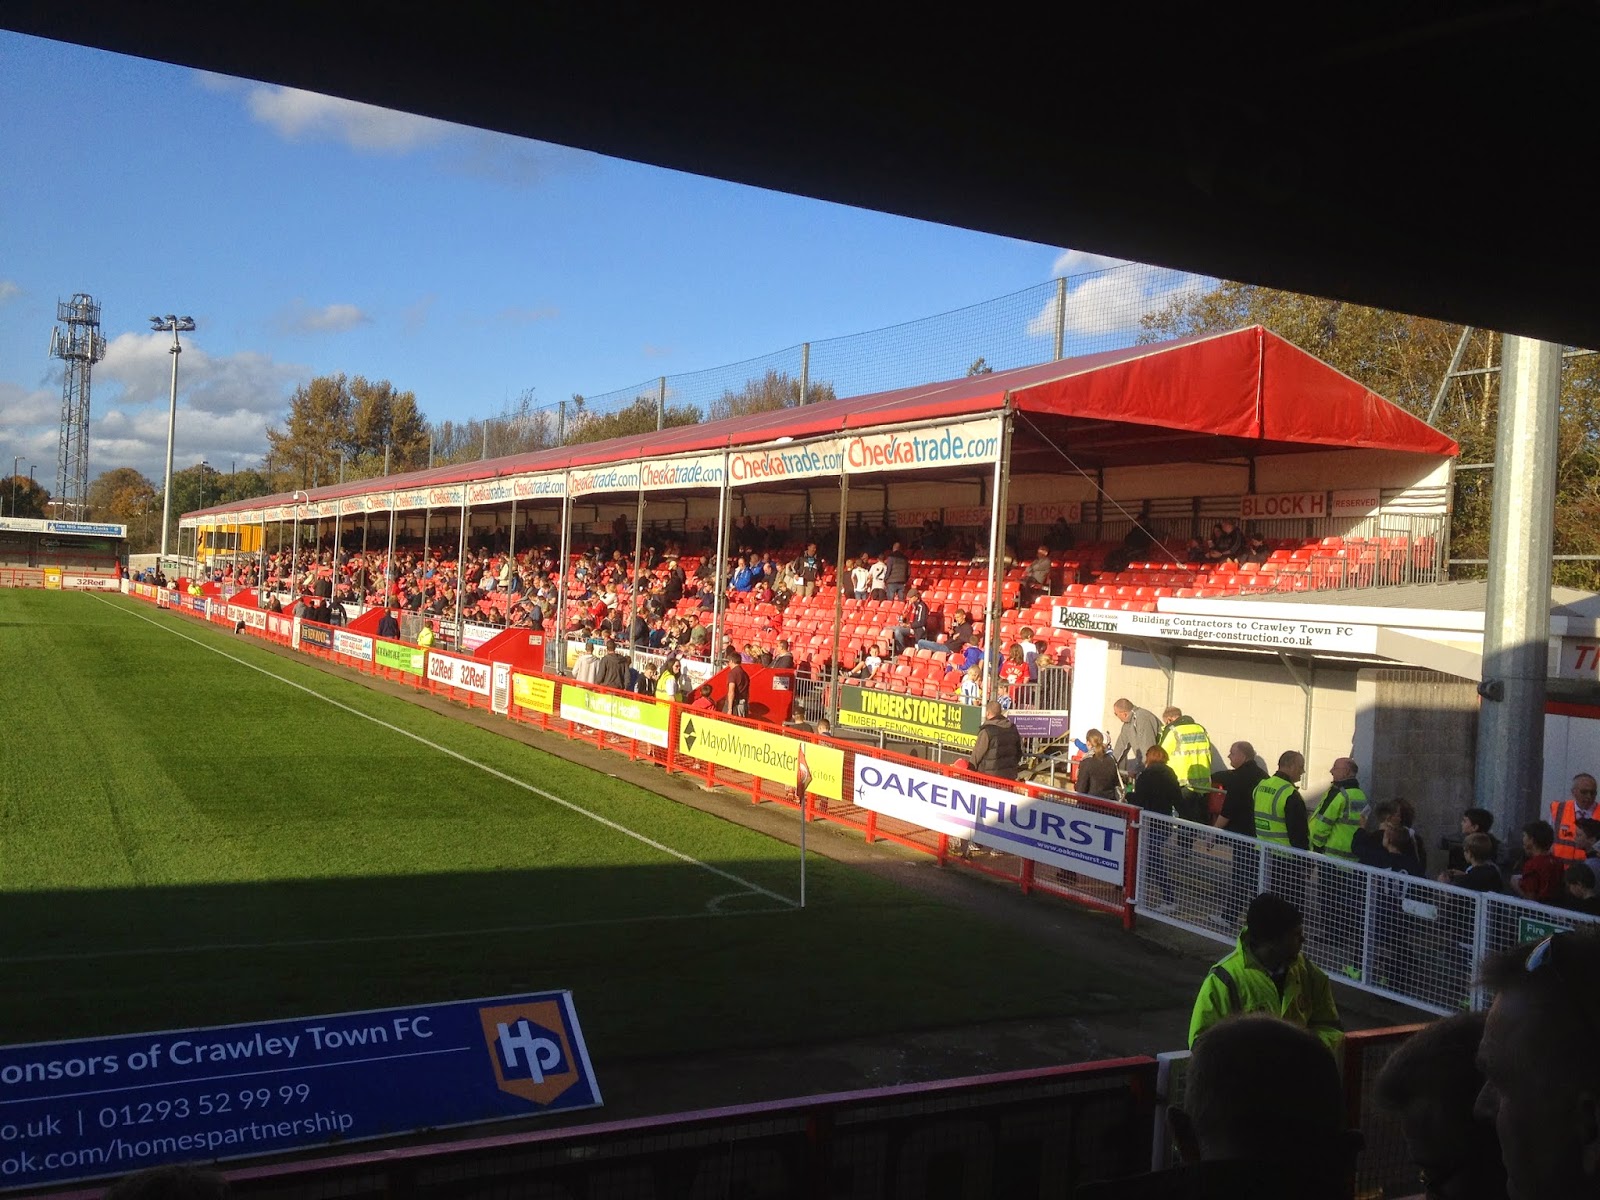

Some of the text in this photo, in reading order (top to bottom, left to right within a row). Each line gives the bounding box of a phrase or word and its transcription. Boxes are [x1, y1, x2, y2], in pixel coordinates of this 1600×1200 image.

[848, 429, 998, 468] Checkatrade.com
[732, 446, 843, 480] Checkatrade.com
[569, 468, 638, 495] Checkatrade.com
[1025, 504, 1065, 521] BLOCK
[1242, 495, 1323, 516] BLOCK H
[1334, 498, 1379, 508] (RESERVED)
[77, 578, 104, 586] 32Red
[1059, 606, 1090, 624] BADGER
[1067, 619, 1118, 631] CONSTRUCTION
[1132, 615, 1170, 626] Building
[1173, 616, 1232, 629] Contractors
[1251, 621, 1296, 634] Crawley
[1300, 624, 1331, 635] Town
[1336, 627, 1353, 636] FC
[1160, 627, 1312, 646] www.badger-construction.co.uk
[430, 657, 452, 680] 32Red
[460, 665, 485, 688] 32Red
[861, 690, 961, 727] TIMBERSTORE ltd
[847, 713, 877, 728] TIMBER
[885, 720, 924, 737] FENCING
[933, 731, 977, 747] DECKING
[700, 728, 799, 772] MayoWynneBaxter
[811, 768, 836, 783] icitors
[860, 766, 1124, 852] OAKENHURST
[1037, 841, 1118, 869] www.oakenhurst.com
[1526, 923, 1545, 935] Fire
[1, 1015, 434, 1084] onsors of Crawley Town FC
[1, 1114, 62, 1141] o.uk
[99, 1098, 190, 1129] 01293
[199, 1093, 233, 1116] 52
[239, 1087, 271, 1110] 99
[278, 1083, 311, 1104] 99
[1, 1110, 354, 1175] ok.com/homespartnership
